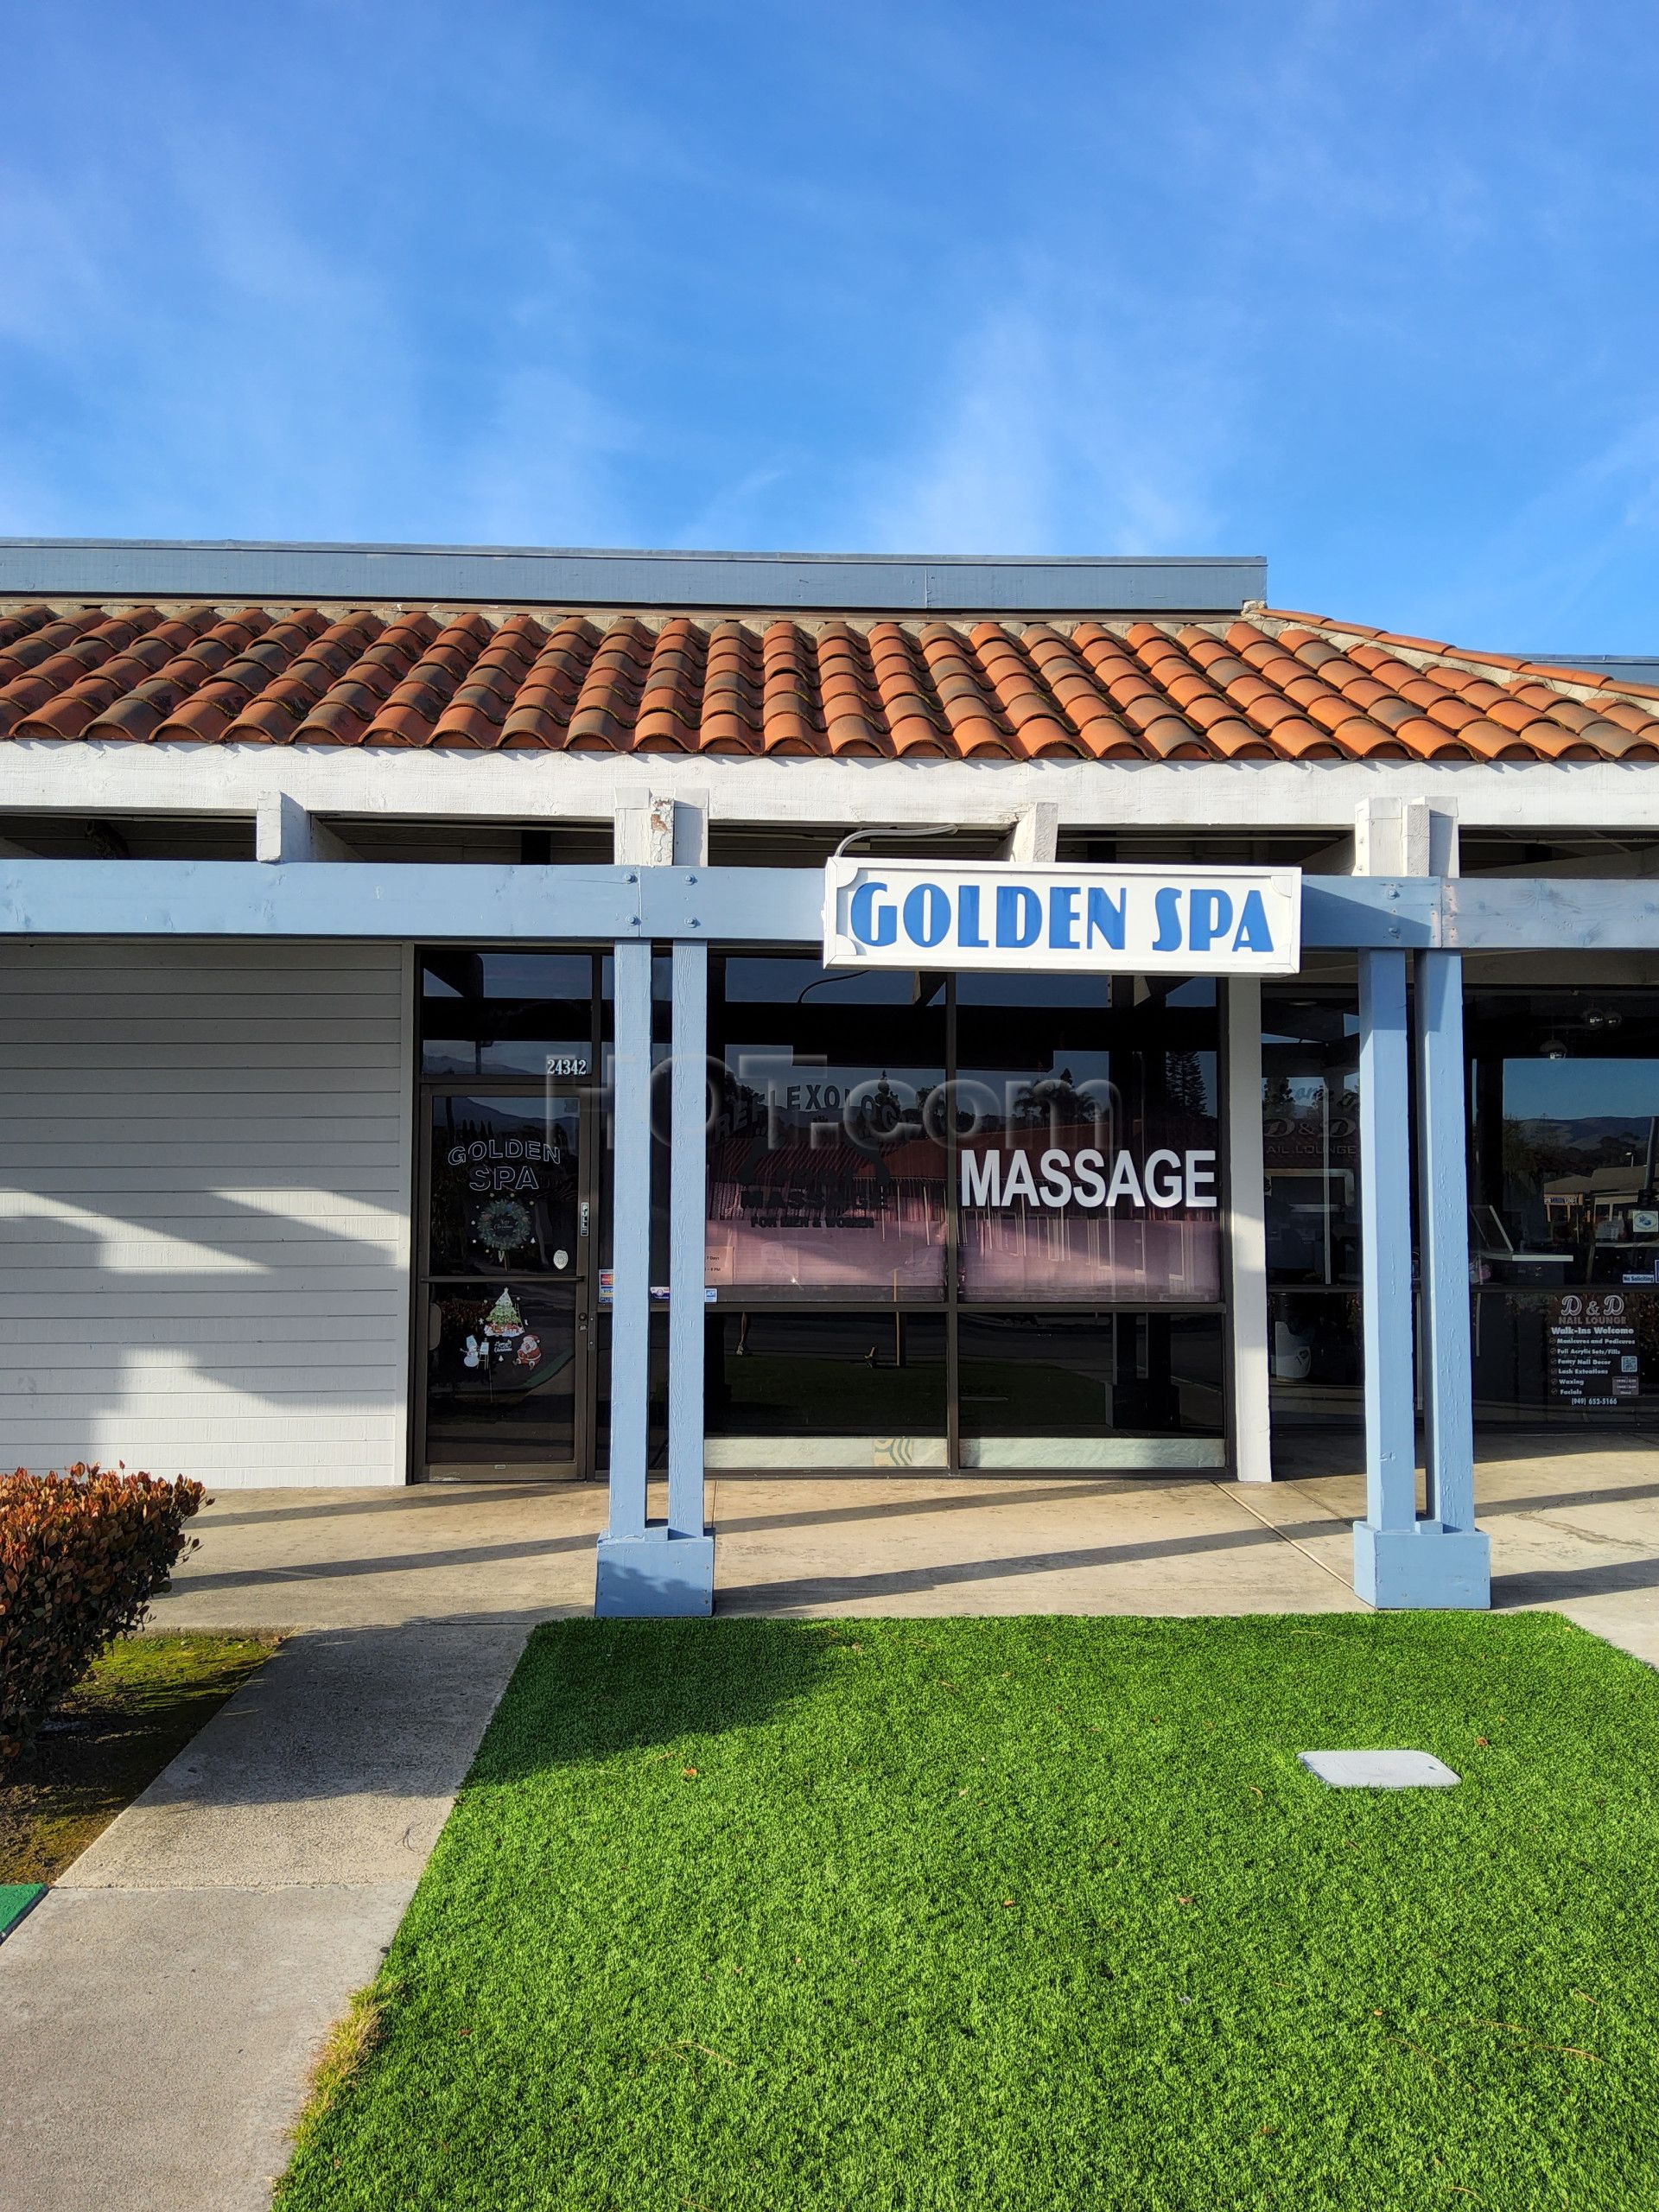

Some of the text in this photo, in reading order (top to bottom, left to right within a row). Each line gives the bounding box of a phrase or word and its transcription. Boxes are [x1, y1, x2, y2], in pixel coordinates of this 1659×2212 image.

[850, 881, 1274, 952] GOLDEN SPA
[547, 1059, 587, 1075] 24342
[1262, 1117, 1357, 1138] D & D
[448, 1139, 561, 1166] GOLDEN
[1266, 1145, 1290, 1154] AIL
[469, 1166, 540, 1192] SPA
[962, 1149, 1217, 1207] MASSAGE
[751, 1216, 874, 1229] FOR MEN & WOMEN
[1560, 1295, 1624, 1316] D & D
[1551, 1326, 1635, 1335] Walk-Ins Welcome
